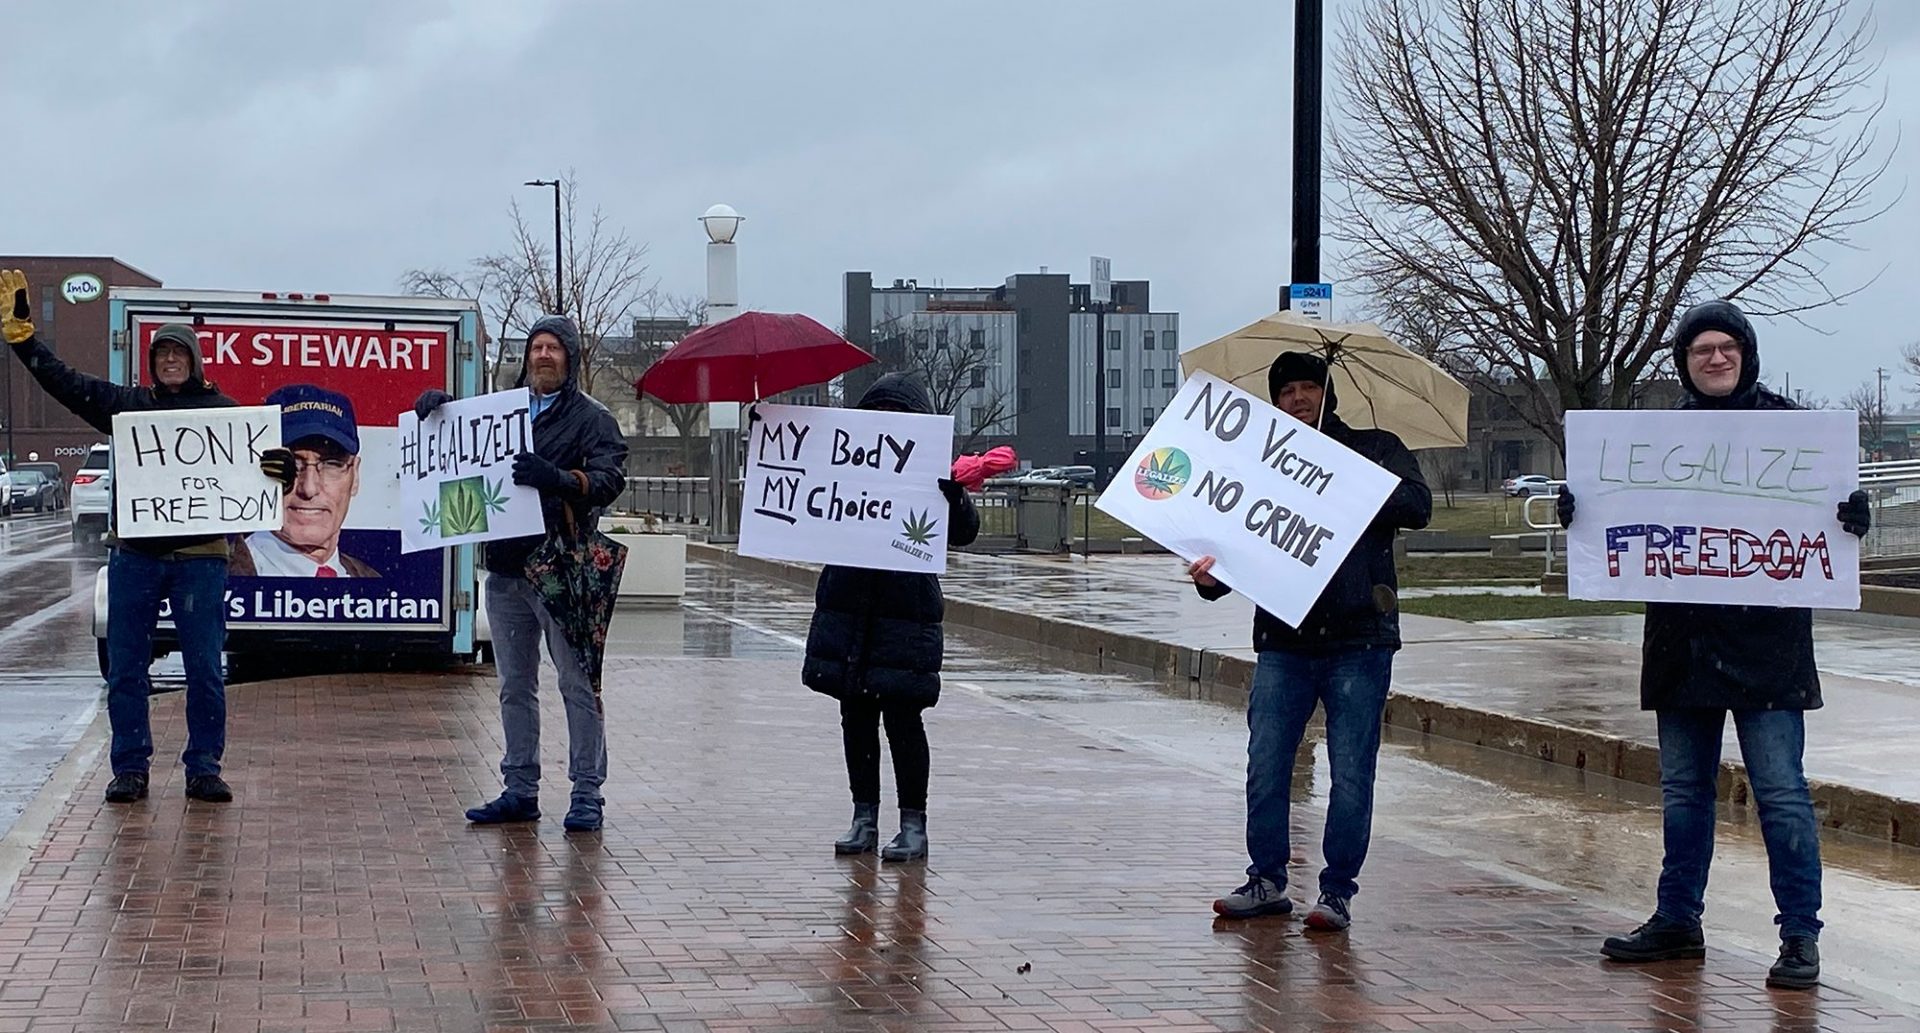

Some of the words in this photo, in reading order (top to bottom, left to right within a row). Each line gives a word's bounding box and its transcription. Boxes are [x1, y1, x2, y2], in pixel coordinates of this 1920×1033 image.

[67, 281, 98, 293] ImOn
[1303, 287, 1326, 297] 5241
[251, 333, 439, 371] STEWART
[281, 401, 343, 418] IBERTARIAN
[1184, 382, 1251, 442] NO
[131, 422, 268, 467] HONK
[758, 420, 811, 462] MY
[181, 477, 223, 491] FOR
[1138, 467, 1187, 486] LEGALIZE
[1598, 439, 1829, 493] LEGALIZE
[131, 486, 279, 524] FREEDOM
[762, 475, 800, 512] MY
[807, 481, 892, 522] Choice
[1193, 471, 1244, 513] NO
[1245, 498, 1335, 567] CRIME
[1605, 523, 1834, 581] FREEDOM
[255, 590, 440, 620] Libertarian
